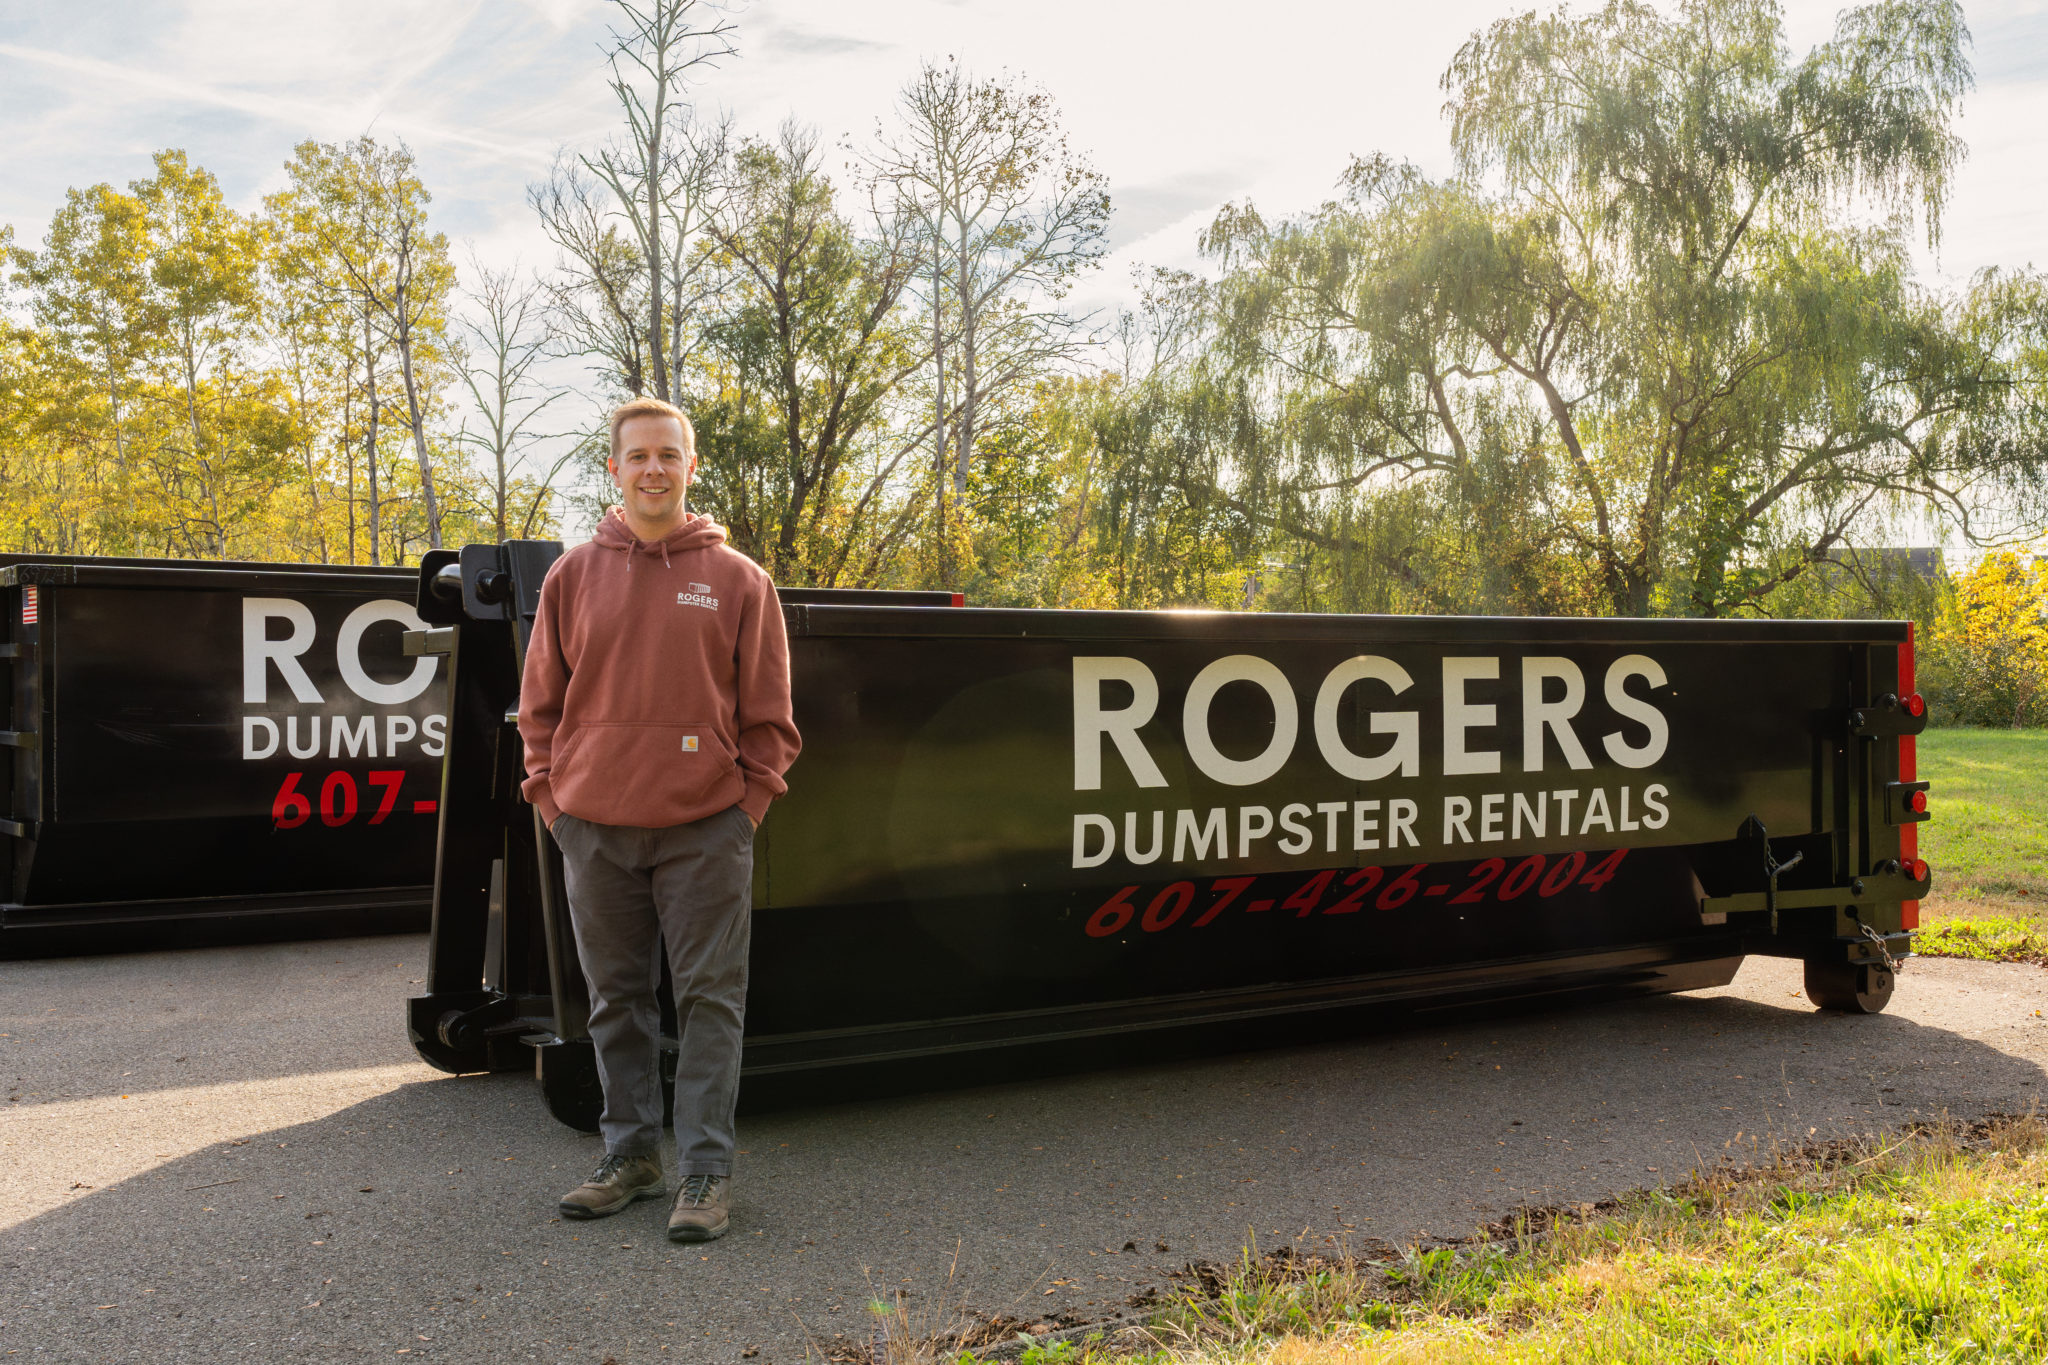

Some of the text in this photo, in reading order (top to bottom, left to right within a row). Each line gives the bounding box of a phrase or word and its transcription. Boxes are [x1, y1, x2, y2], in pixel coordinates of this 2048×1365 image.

[677, 592, 719, 607] ROGERS
[1072, 655, 1669, 791] ROGERS
[1072, 783, 1670, 869] DUMPSTER RENTALS
[1084, 848, 1630, 938] 607-426-2004
